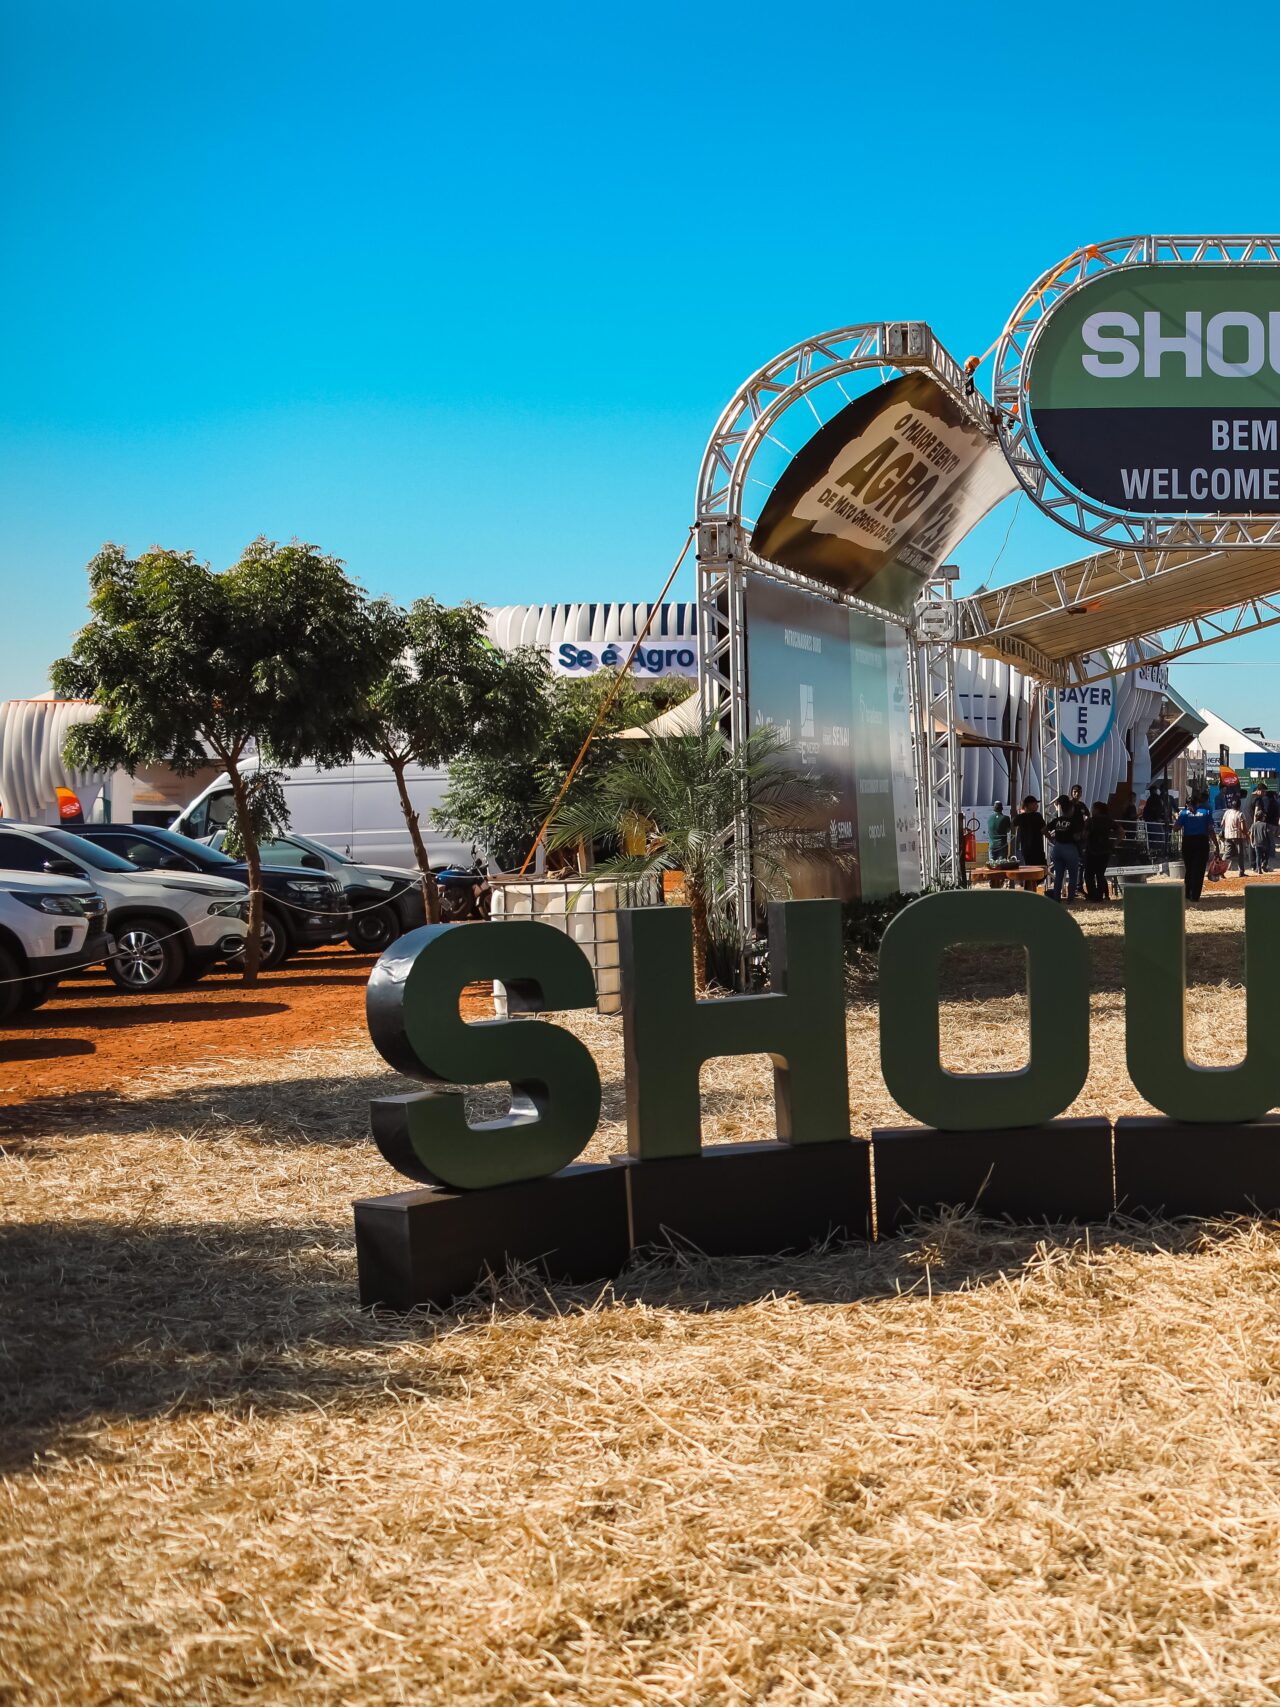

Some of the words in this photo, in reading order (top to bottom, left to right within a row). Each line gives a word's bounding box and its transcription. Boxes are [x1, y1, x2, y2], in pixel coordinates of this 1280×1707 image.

[894, 413, 914, 431] O
[901, 419, 938, 454] MAIOR
[926, 441, 960, 475] EVENTO
[834, 436, 939, 524] AGRO
[817, 488, 838, 508] DE
[831, 495, 856, 520] MATO
[852, 509, 881, 536] GROSSO
[558, 643, 593, 668] Se
[601, 643, 617, 666] é
[1059, 687, 1111, 706] BAYER
